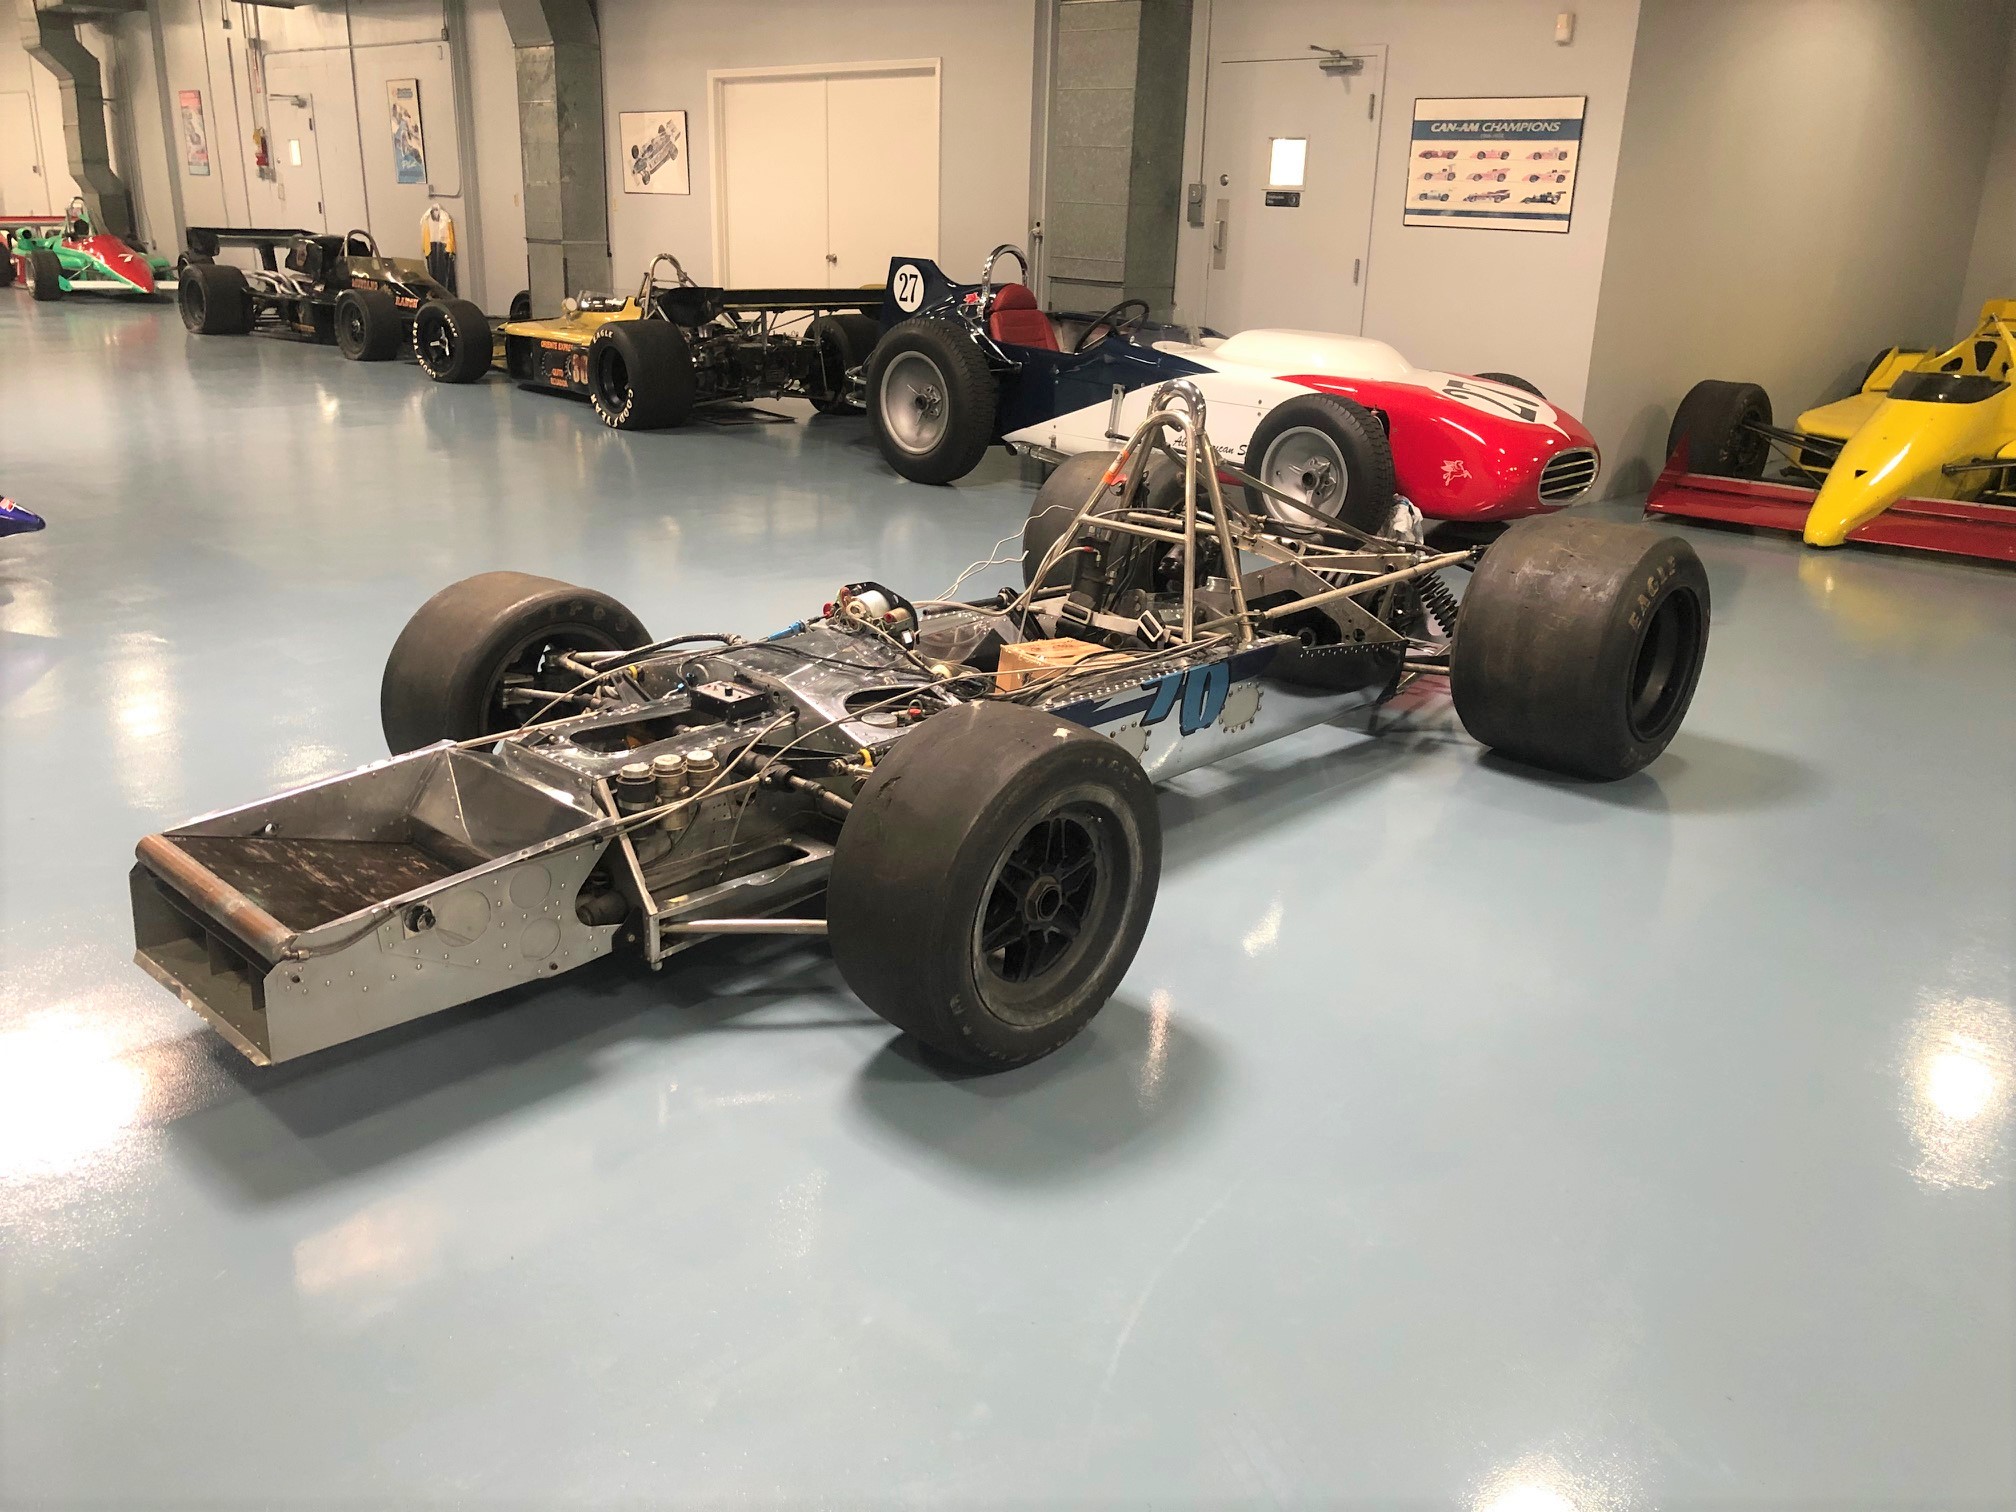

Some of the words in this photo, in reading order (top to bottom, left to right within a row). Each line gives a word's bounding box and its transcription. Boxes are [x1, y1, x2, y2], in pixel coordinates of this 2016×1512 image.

[1430, 122, 1479, 132] CAN-AM
[1482, 121, 1561, 132] CHAMPIONS
[899, 273, 918, 303] 27
[593, 329, 613, 343] EAGLE
[590, 388, 634, 428] GOODYEAR
[1442, 379, 1540, 422] 27
[1139, 661, 1231, 737] 70
